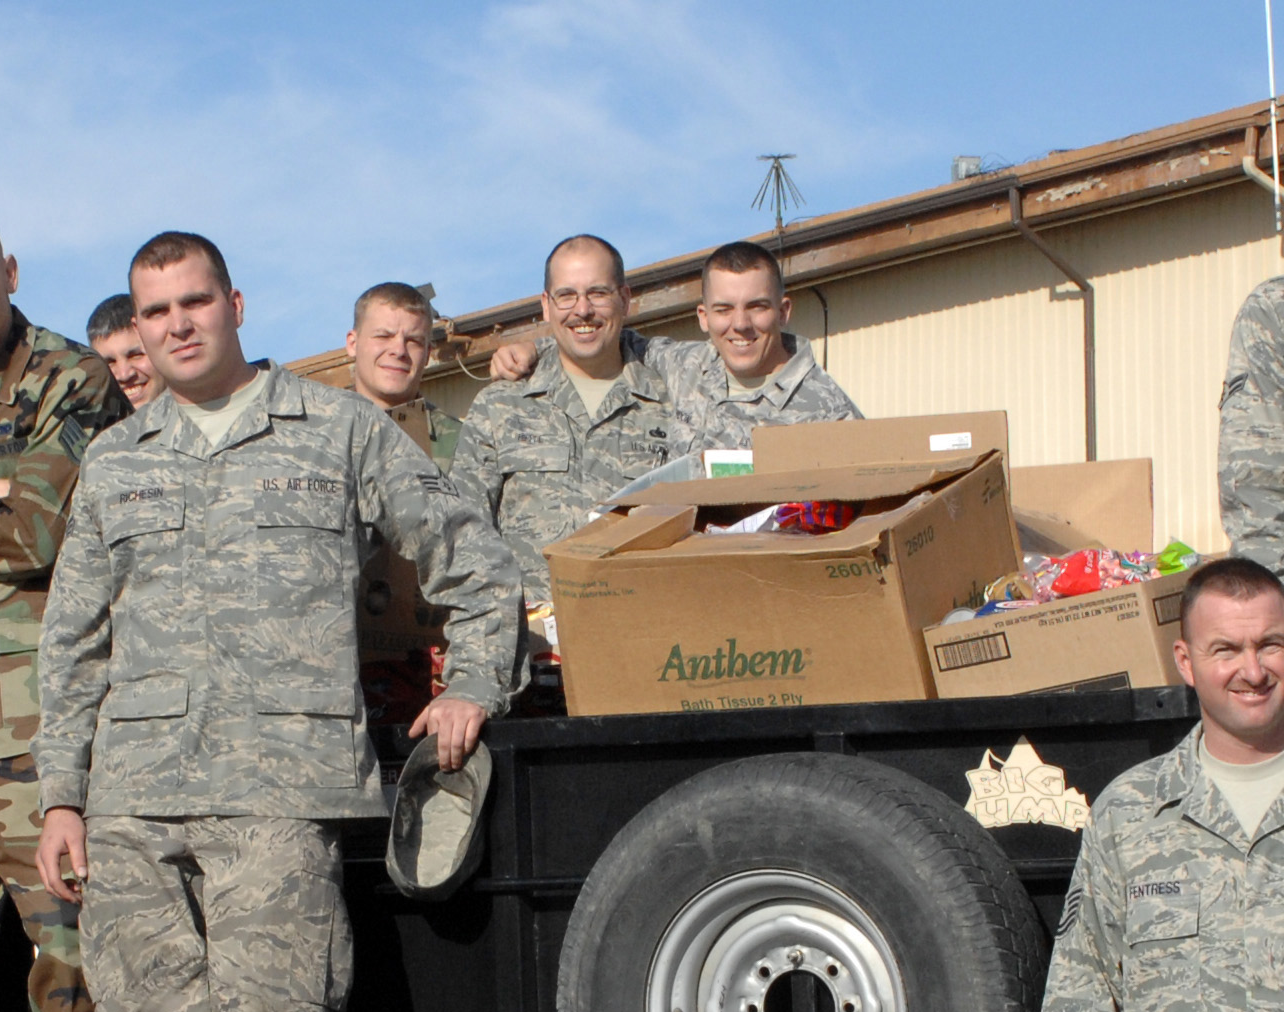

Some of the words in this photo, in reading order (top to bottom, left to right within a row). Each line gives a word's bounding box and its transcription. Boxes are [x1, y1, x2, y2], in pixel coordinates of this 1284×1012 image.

[262, 478, 279, 491] U.S.
[286, 478, 302, 491] AIR
[307, 478, 337, 493] FORCE
[119, 487, 164, 504] RICHESIN
[905, 525, 935, 556] 26010
[657, 638, 805, 682] Anthem
[681, 699, 715, 711] Bath
[717, 695, 765, 708] Tissue
[768, 694, 778, 706] 2
[781, 692, 803, 706] Ply
[966, 765, 1064, 800] BIG
[1129, 881, 1181, 900] FENTRESS
